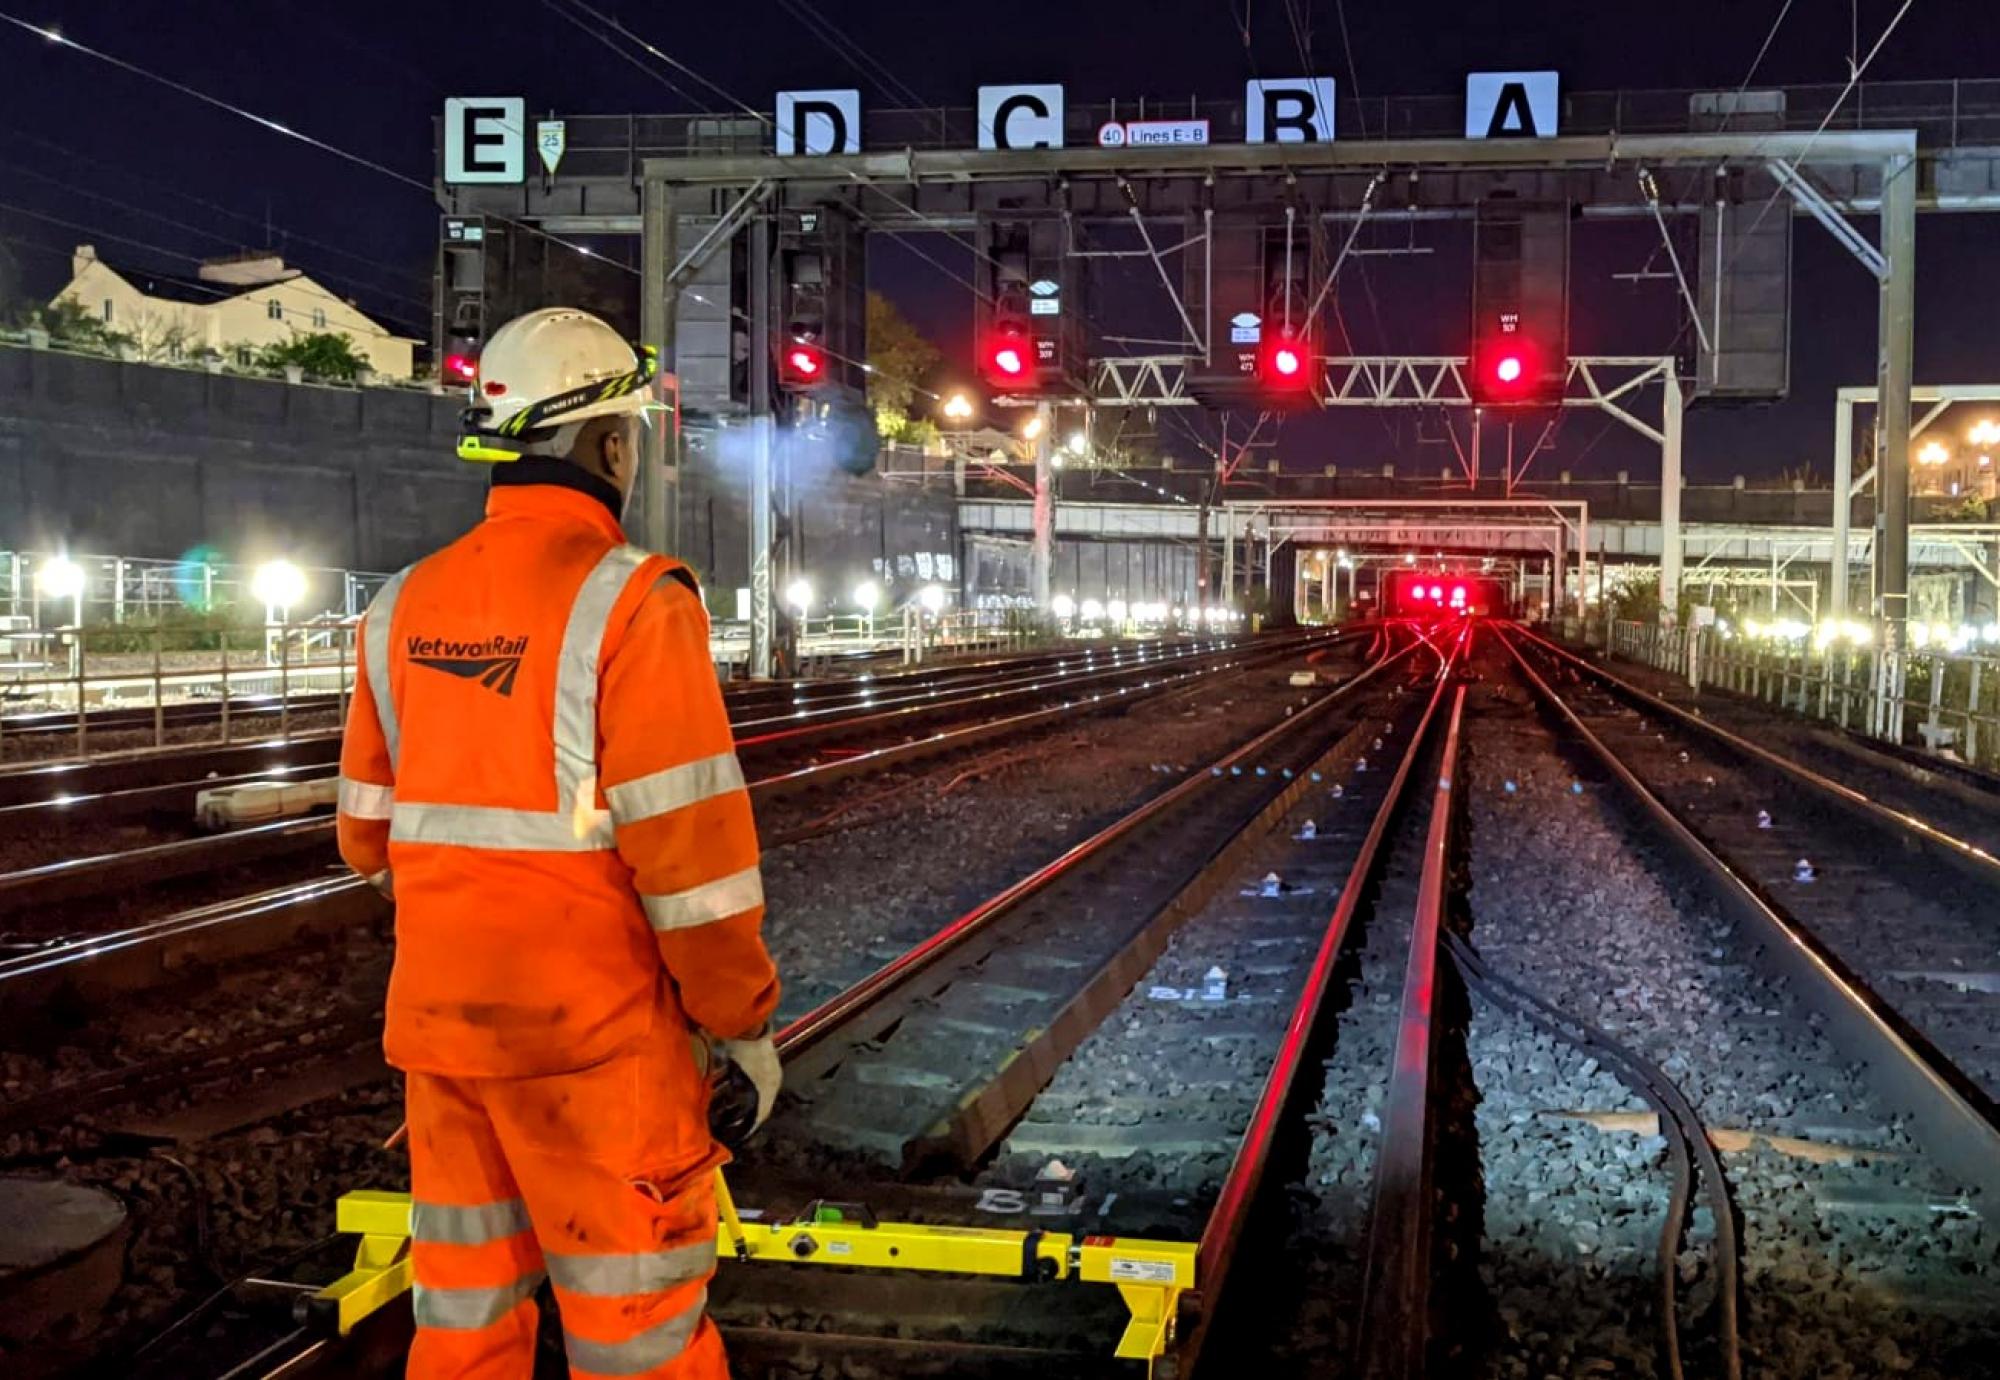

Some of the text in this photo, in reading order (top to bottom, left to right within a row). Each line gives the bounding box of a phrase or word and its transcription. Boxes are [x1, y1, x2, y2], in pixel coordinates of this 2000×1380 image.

[793, 101, 848, 157] D
[993, 94, 1050, 148] C
[1102, 128, 1121, 142] 40
[1130, 128, 1170, 143] Lines
[1173, 128, 1183, 142] E
[1193, 128, 1204, 142] B
[1485, 82, 1538, 139] A
[463, 107, 506, 173] E
[544, 134, 559, 147] 25
